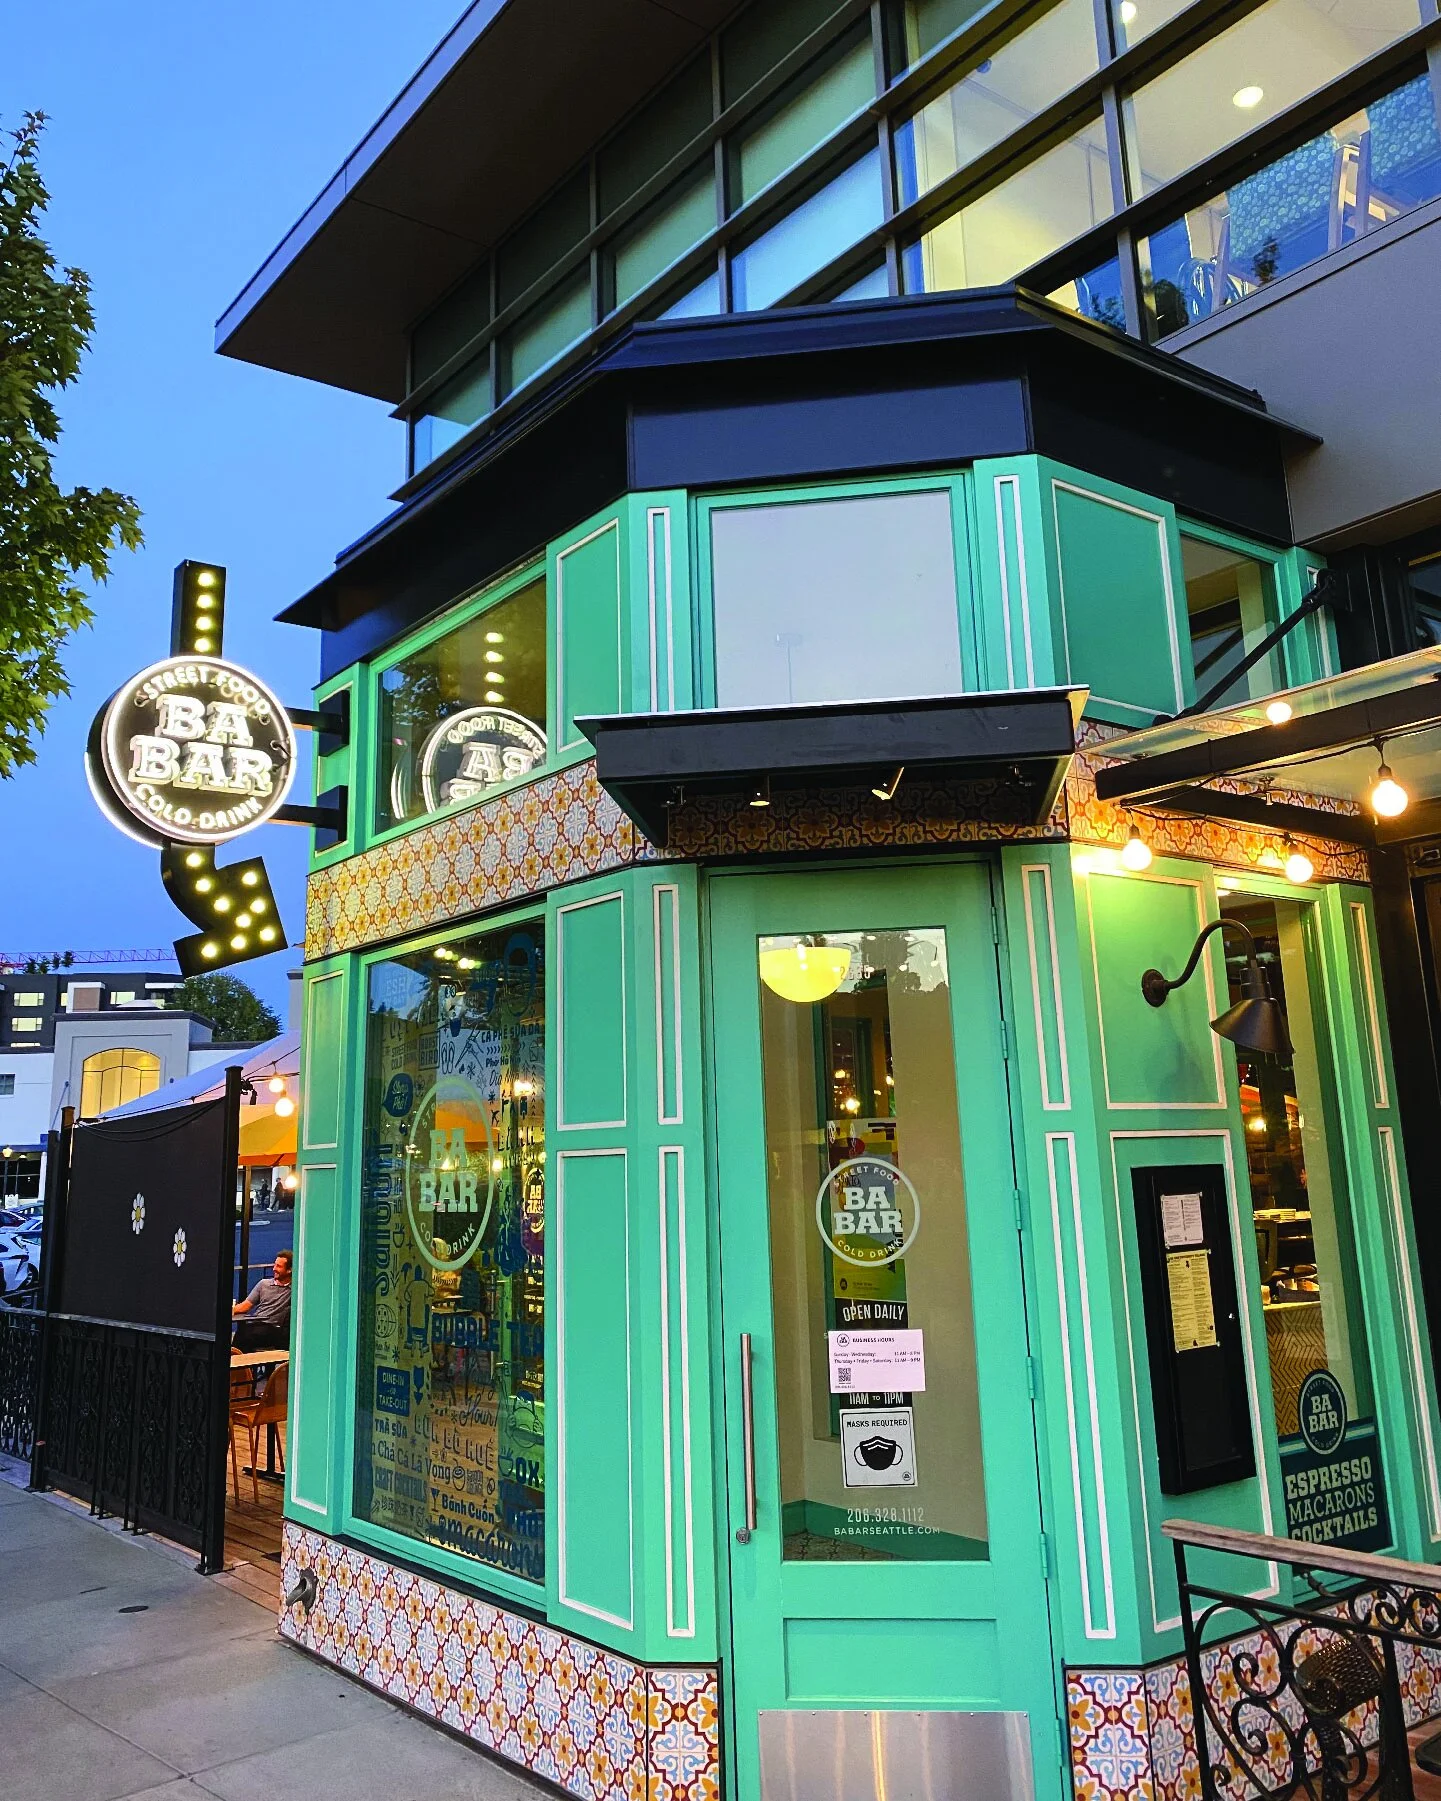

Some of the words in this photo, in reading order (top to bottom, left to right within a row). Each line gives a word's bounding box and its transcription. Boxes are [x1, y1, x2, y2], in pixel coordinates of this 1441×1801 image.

[143, 666, 210, 700] STREET
[215, 670, 271, 715] FOOD
[154, 693, 254, 747] BA
[128, 735, 273, 798] BAR
[134, 784, 192, 825] COLD
[199, 796, 264, 829] DRINK
[428, 1127, 468, 1169] BA
[833, 1166, 868, 1187] STREET
[874, 1167, 900, 1185] FOOD
[418, 1171, 478, 1213] BAR
[843, 1186, 890, 1210] BA
[833, 1210, 904, 1235] BAR
[837, 1239, 864, 1258] COLD
[869, 1238, 904, 1258] DRINK
[842, 1304, 871, 1322] OPEN
[874, 1303, 905, 1321] DAILY
[382, 1372, 404, 1386] DINE-IN
[379, 1394, 407, 1411] TAKE-OUT
[849, 1391, 869, 1404] 11AM
[884, 1391, 904, 1405] 11PM
[1311, 1393, 1333, 1413] BA
[872, 1419, 908, 1428] REQUIRED
[1308, 1411, 1339, 1432] BAR
[1285, 1455, 1372, 1500] ESPRESSO
[441, 1494, 467, 1516] Bánh
[1288, 1482, 1375, 1525] MACARONS
[847, 1507, 925, 1523] 206.328.1112
[1291, 1507, 1378, 1544] COCKTAILS
[834, 1526, 941, 1536] BABARSEATTLE.COM
